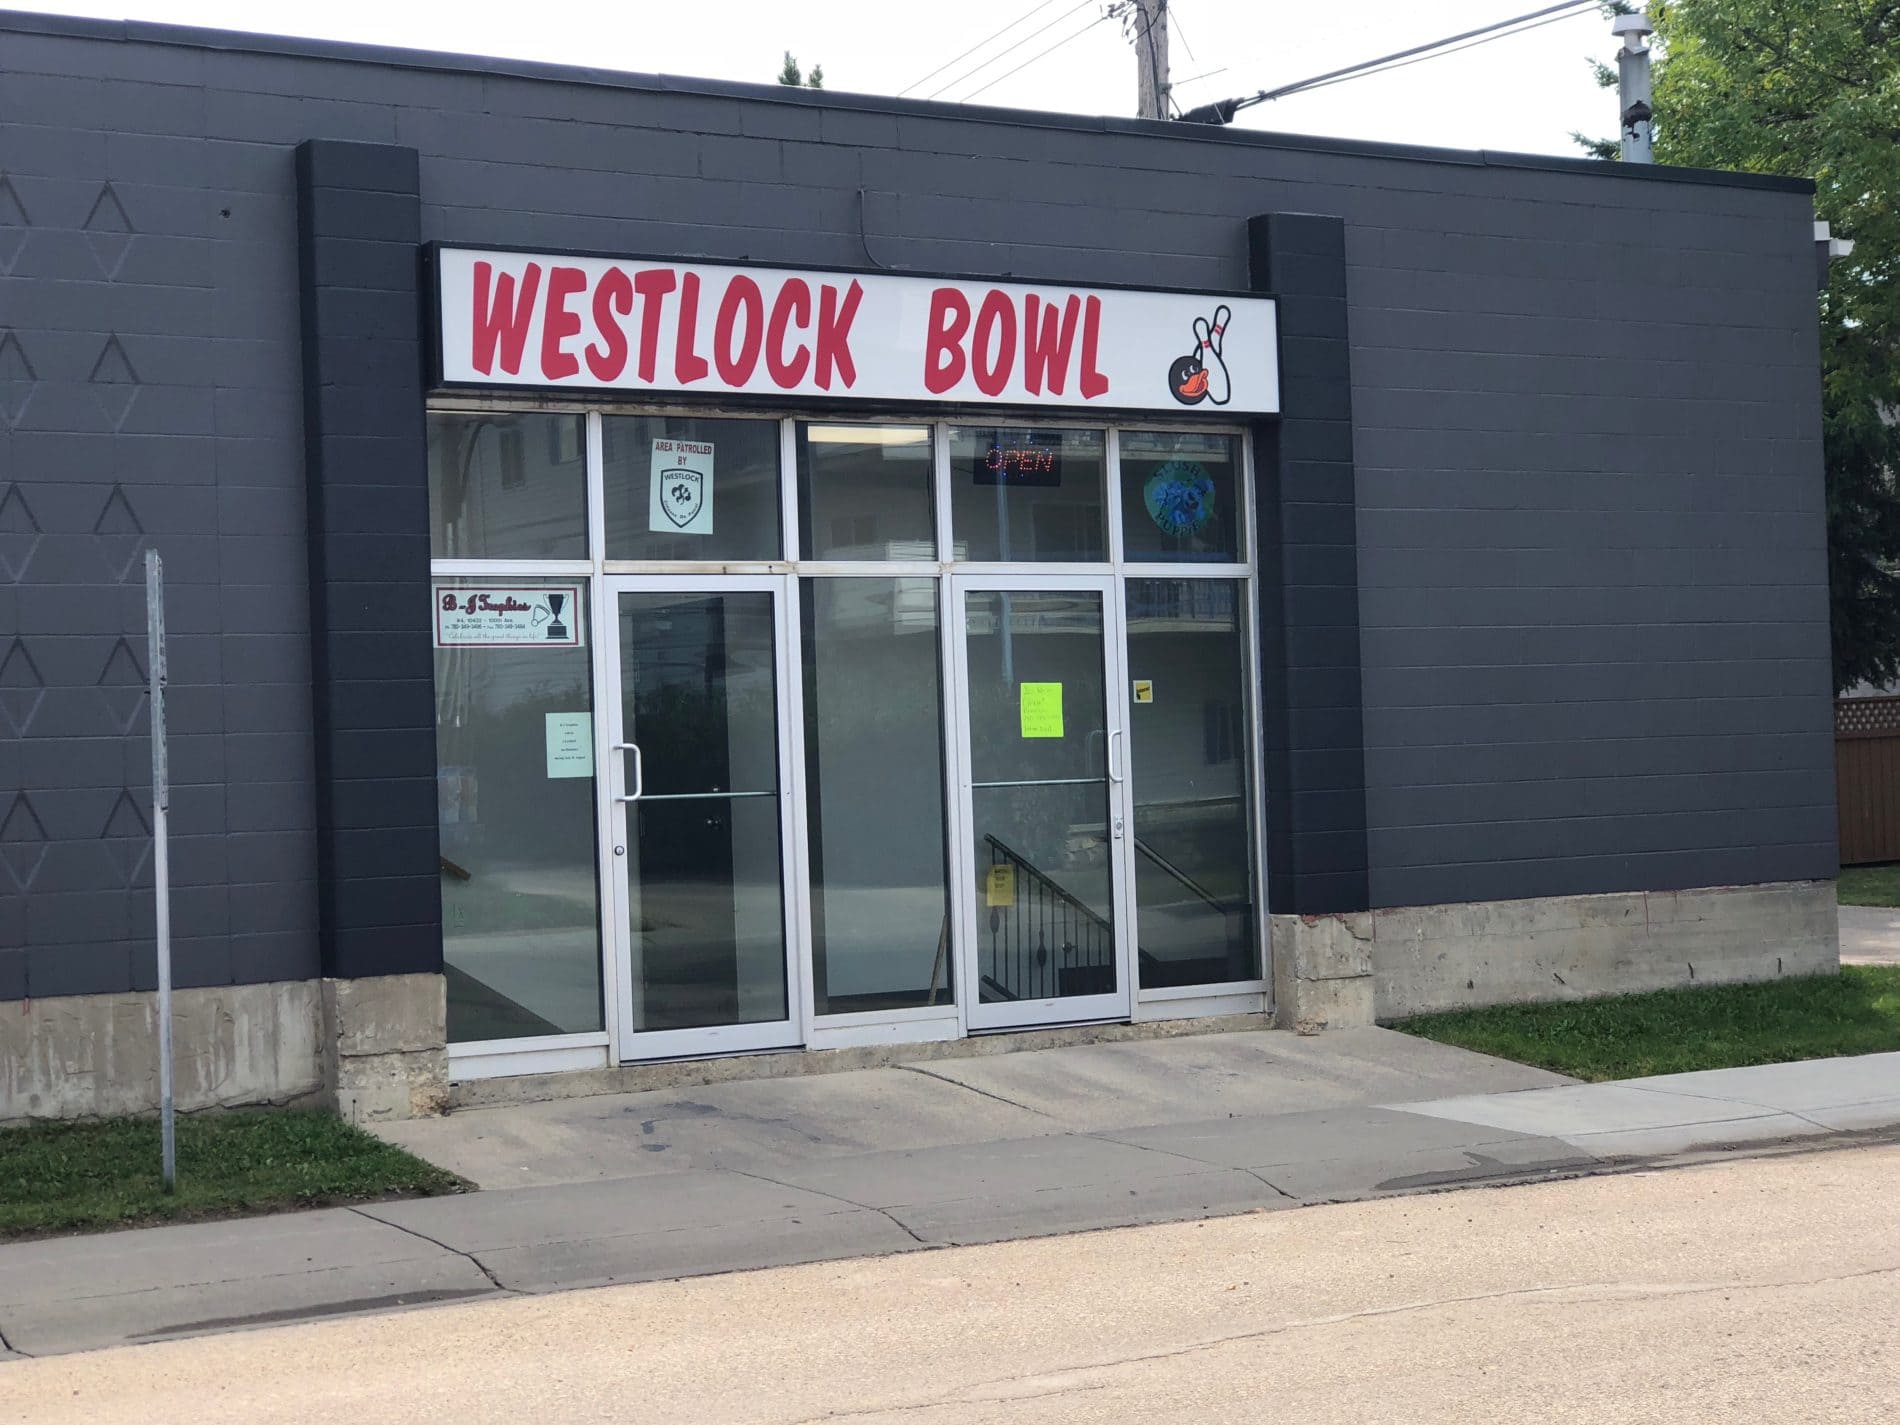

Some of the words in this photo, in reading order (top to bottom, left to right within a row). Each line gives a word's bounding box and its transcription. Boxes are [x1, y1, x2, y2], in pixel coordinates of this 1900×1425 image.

[473, 263, 862, 389] WESTLOCK
[925, 288, 1108, 398] BOWL
[656, 442, 673, 452] AREA
[677, 443, 712, 455] PATROLLED
[677, 456, 687, 465] BY
[985, 448, 1053, 472] OPEN
[664, 472, 700, 483] WESTLOCK
